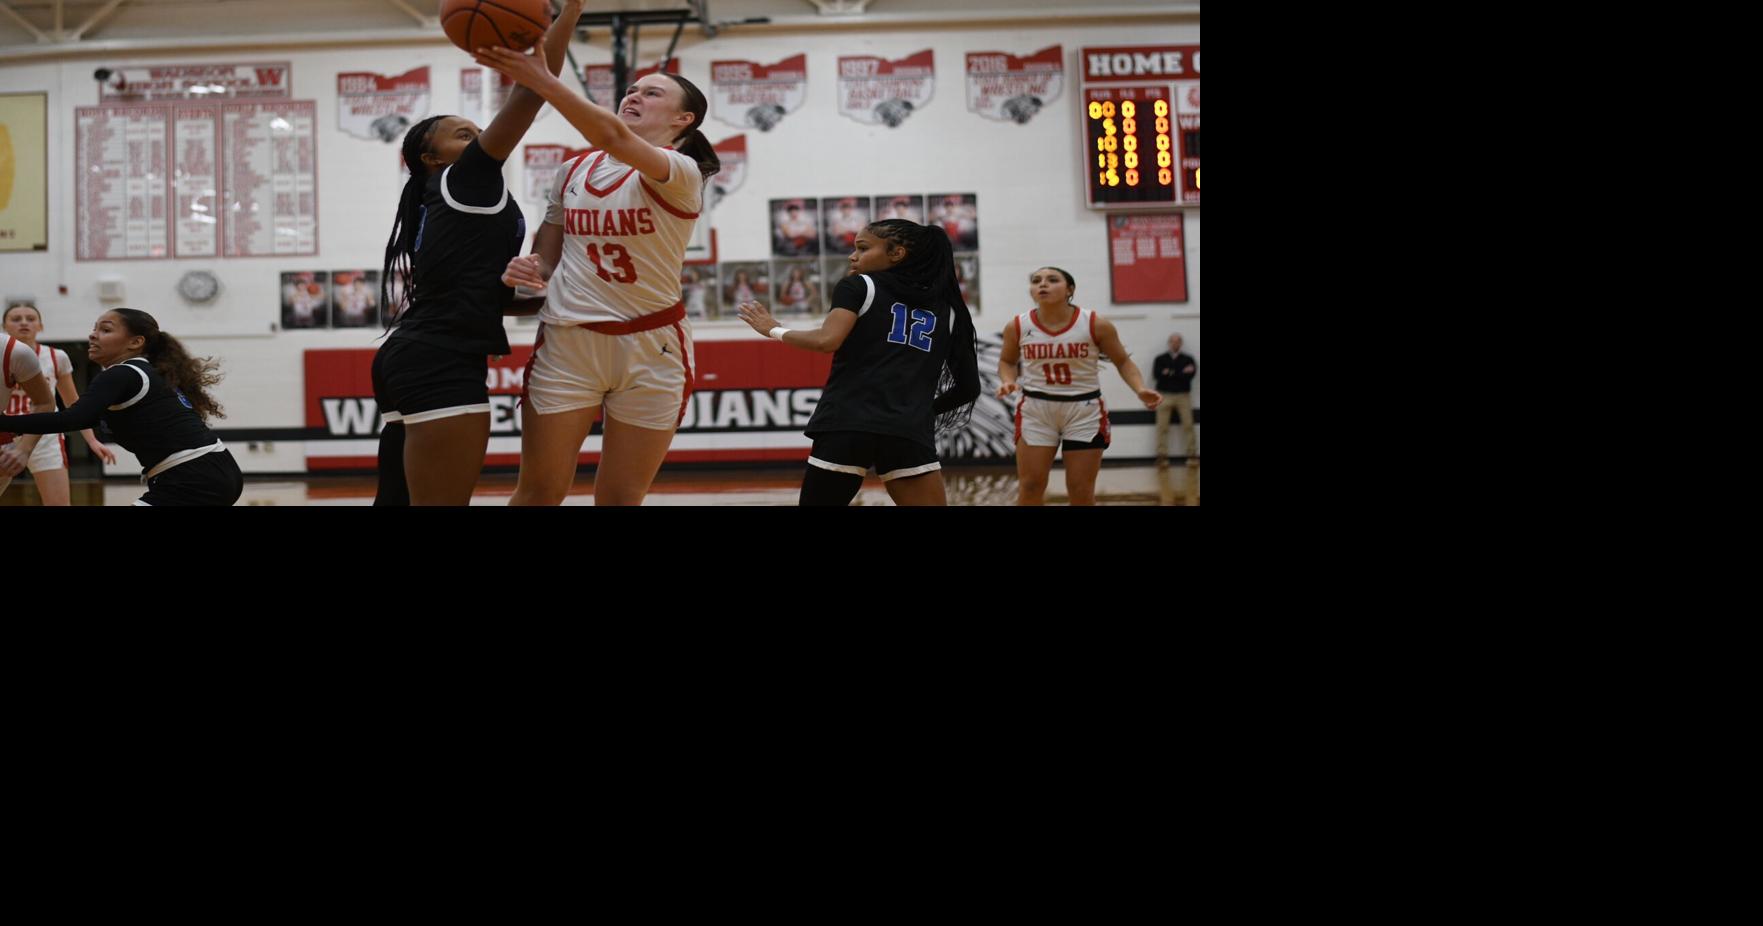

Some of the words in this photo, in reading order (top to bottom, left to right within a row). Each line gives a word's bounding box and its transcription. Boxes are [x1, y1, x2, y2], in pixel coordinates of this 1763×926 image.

[1088, 52, 1183, 76] HOME
[254, 66, 284, 86] W
[1089, 100, 1115, 119] 00
[1121, 100, 1135, 118] 0
[1154, 99, 1168, 117] 0
[1122, 118, 1136, 135] 0
[1155, 117, 1168, 134] 0
[1123, 134, 1137, 152] 0
[1156, 133, 1169, 151] 0
[1124, 151, 1138, 169] 0
[1157, 150, 1171, 168] 0
[1125, 168, 1139, 186] 0
[1158, 168, 1171, 185] 0
[563, 207, 655, 236] NDIANS
[586, 242, 638, 284] 13
[886, 301, 937, 353] 12
[1042, 362, 1073, 385] 10
